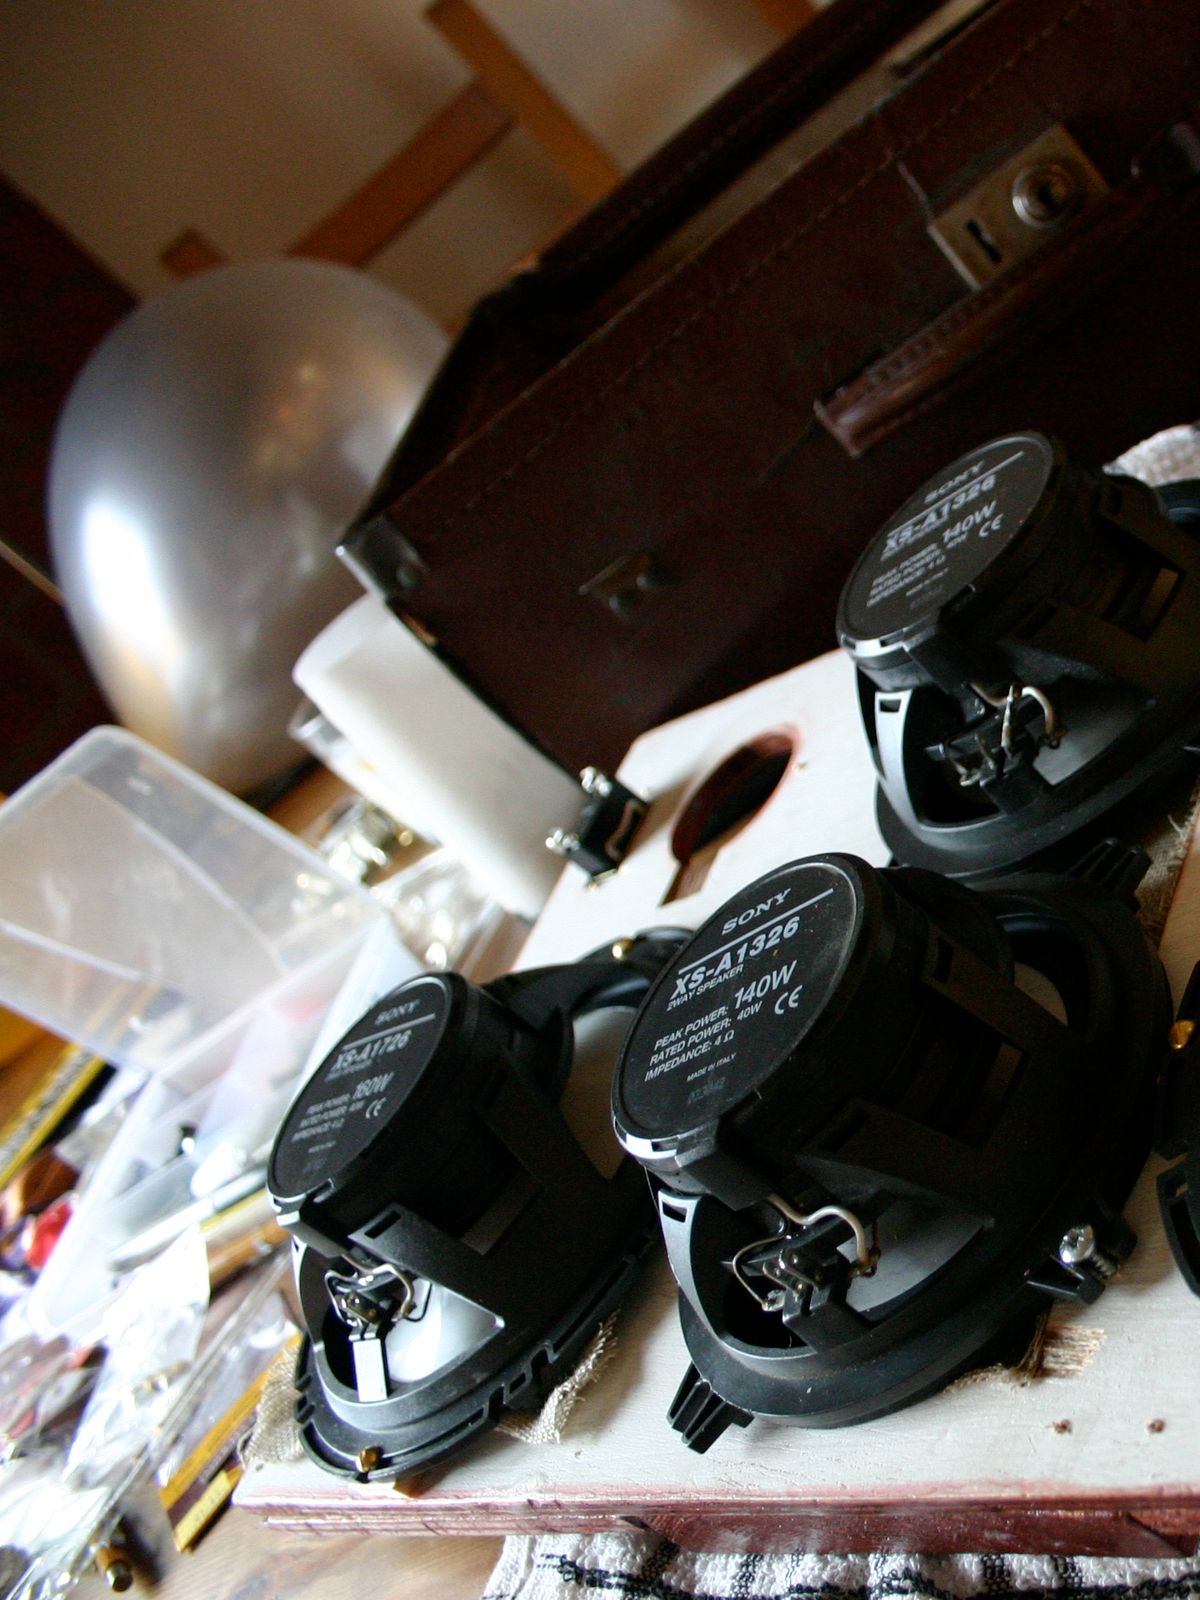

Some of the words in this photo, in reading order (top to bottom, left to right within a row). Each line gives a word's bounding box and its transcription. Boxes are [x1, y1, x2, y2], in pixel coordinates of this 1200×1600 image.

[924, 461, 983, 503] SONY
[883, 474, 995, 556] XS-A1326
[943, 500, 996, 542] 140W
[722, 888, 791, 935] SONY
[670, 916, 800, 1002] XS-A1326
[696, 964, 743, 995] SPEAKER
[375, 1000, 417, 1024] SONY
[654, 1028, 683, 1051] PEAK
[684, 1006, 728, 1035] POWER:
[735, 960, 797, 1009] 140W
[328, 1030, 411, 1076] XS-A1726
[649, 1040, 685, 1066] RATED
[687, 1018, 731, 1047] POWER:
[737, 1001, 762, 1020] 40W
[644, 1040, 712, 1082] IMPEDANCE:
[352, 1072, 393, 1100] 160W
